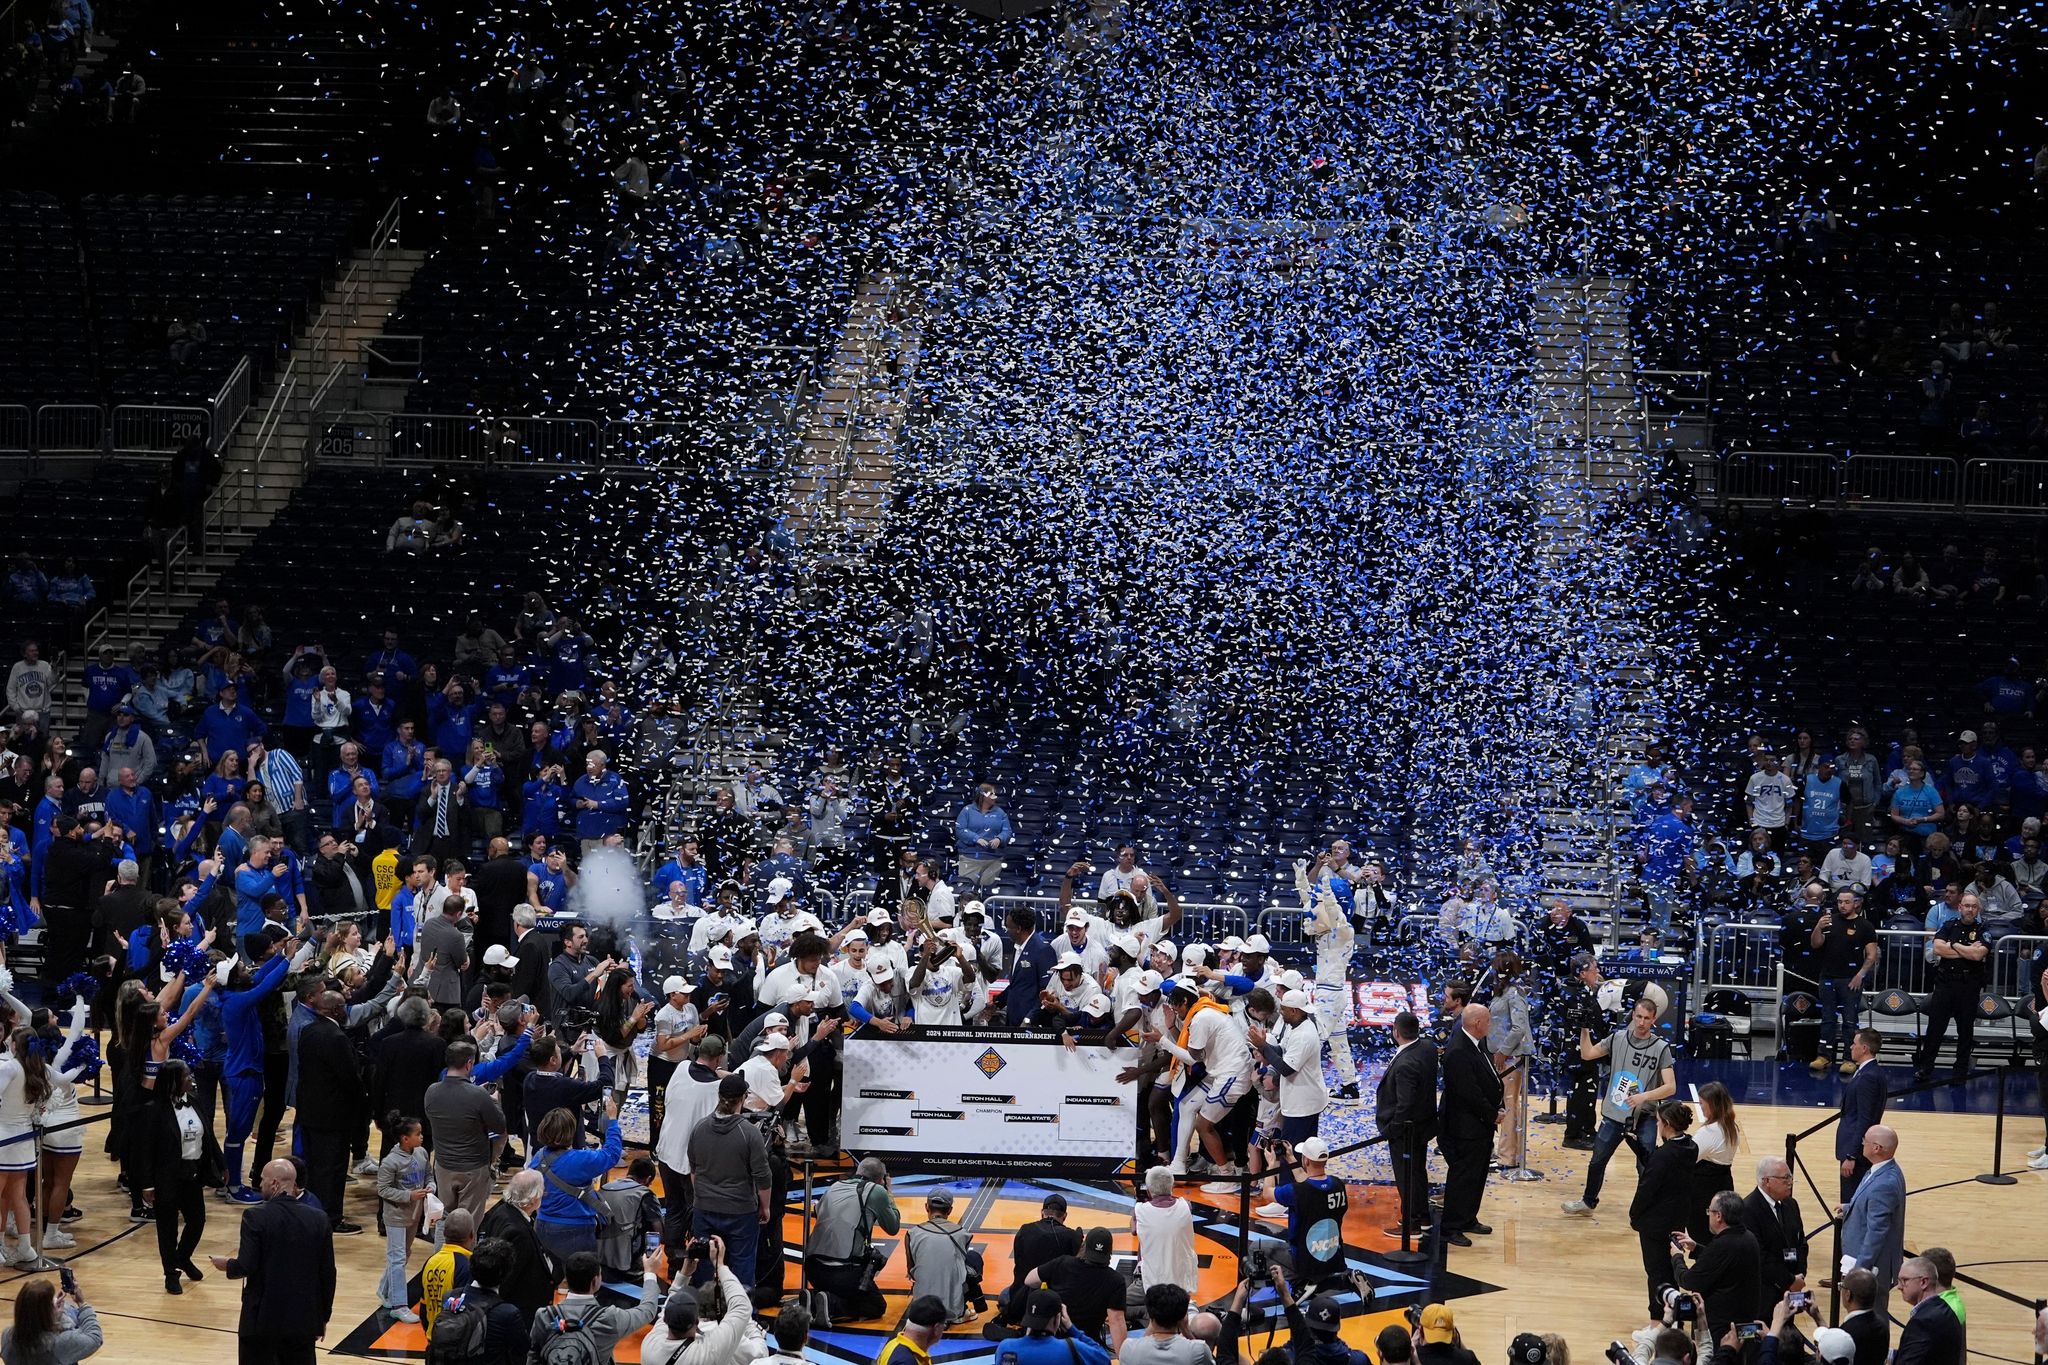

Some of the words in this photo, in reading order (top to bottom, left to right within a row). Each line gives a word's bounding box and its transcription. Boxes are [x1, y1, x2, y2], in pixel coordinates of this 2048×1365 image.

[172, 422, 202, 439] 204
[323, 437, 352, 454] 205
[1814, 799, 1826, 810] 21
[376, 865, 394, 874] CSC
[535, 919, 565, 929] AWGS
[1600, 966, 1618, 974] THE
[1620, 966, 1655, 975] BUTLER
[942, 1030, 974, 1038] NATIONAL
[975, 1031, 1012, 1039] INVITATION
[1013, 1032, 1056, 1040] TOURNAMENT
[1631, 1051, 1658, 1070] 573
[1327, 1191, 1346, 1210] 571
[427, 1269, 447, 1282] CSC
